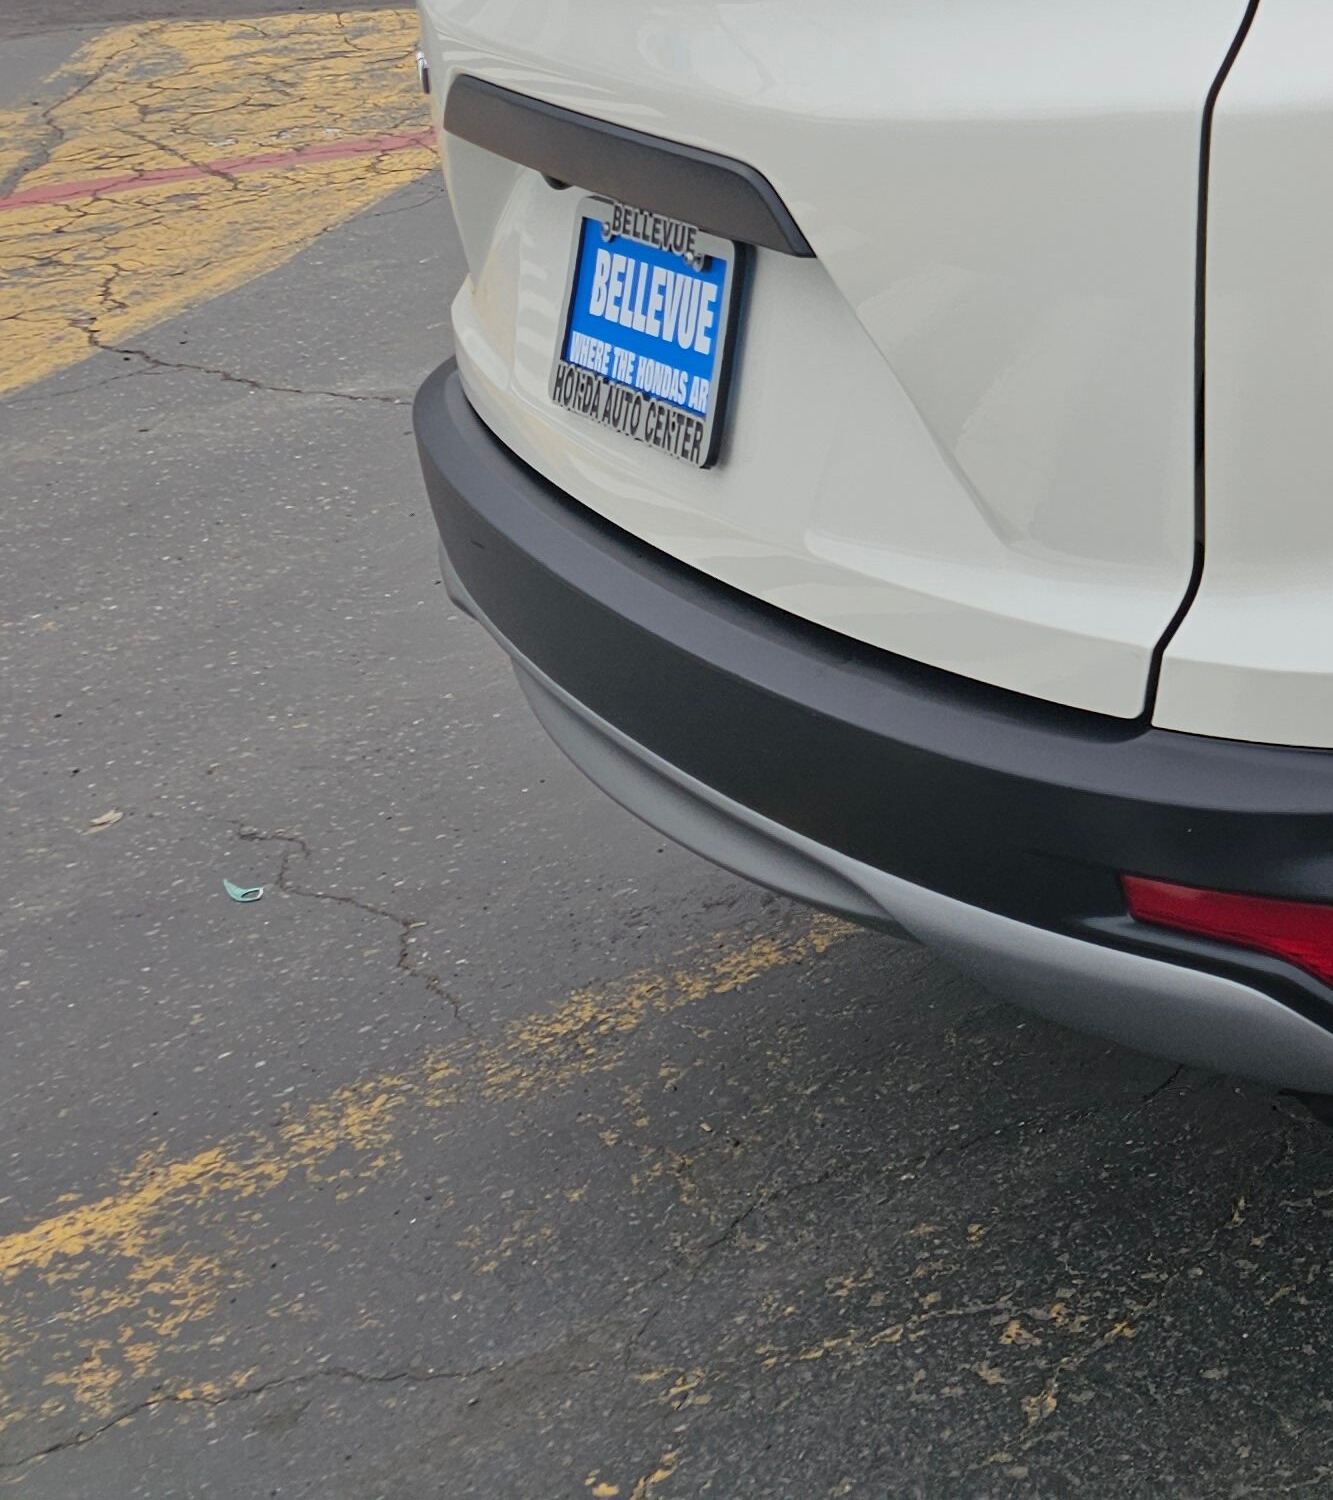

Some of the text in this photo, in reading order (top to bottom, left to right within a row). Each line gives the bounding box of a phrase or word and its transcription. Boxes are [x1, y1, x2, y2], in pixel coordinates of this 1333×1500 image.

[611, 204, 698, 253] BELLEVUE
[589, 247, 718, 356] BELLEVUE
[552, 363, 704, 465] HONDA AUTO CENTER
[569, 330, 710, 414] WHERE THE HONDAS AR
